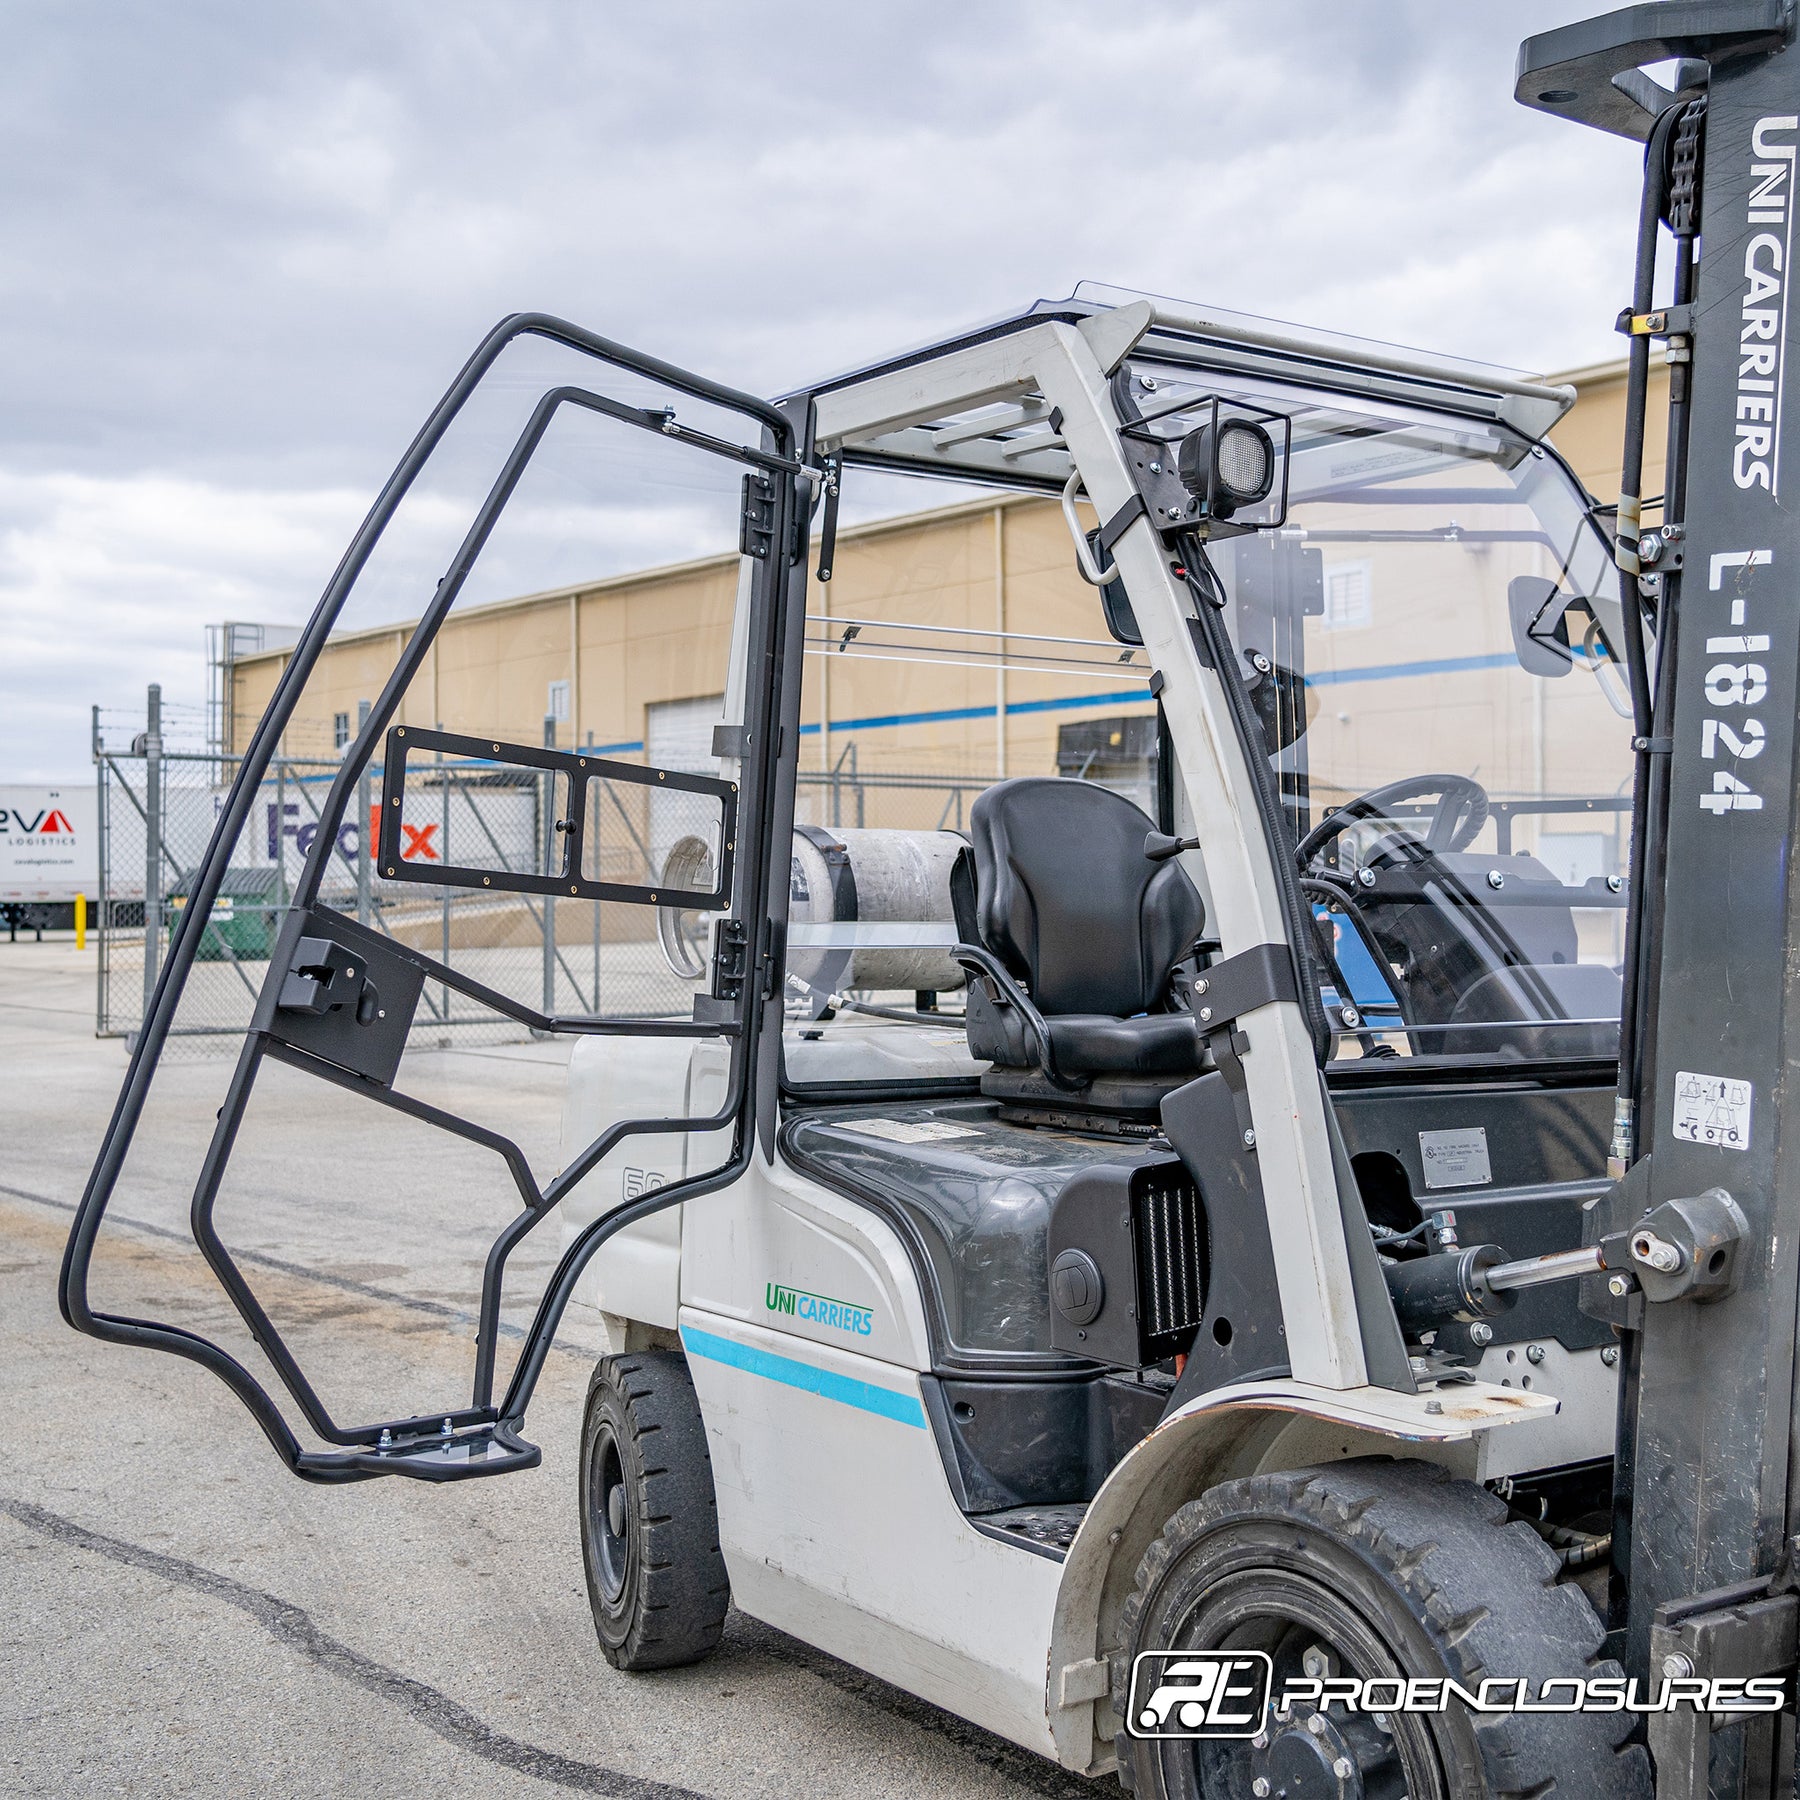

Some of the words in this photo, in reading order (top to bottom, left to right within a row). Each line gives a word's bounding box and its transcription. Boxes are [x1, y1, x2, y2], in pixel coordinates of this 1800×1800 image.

[1732, 115, 1799, 498] UNICARRIERS
[1699, 550, 1772, 815] L-1824
[9, 838, 76, 846] LOGISTICS
[766, 1282, 874, 1336] UNICARRIERS
